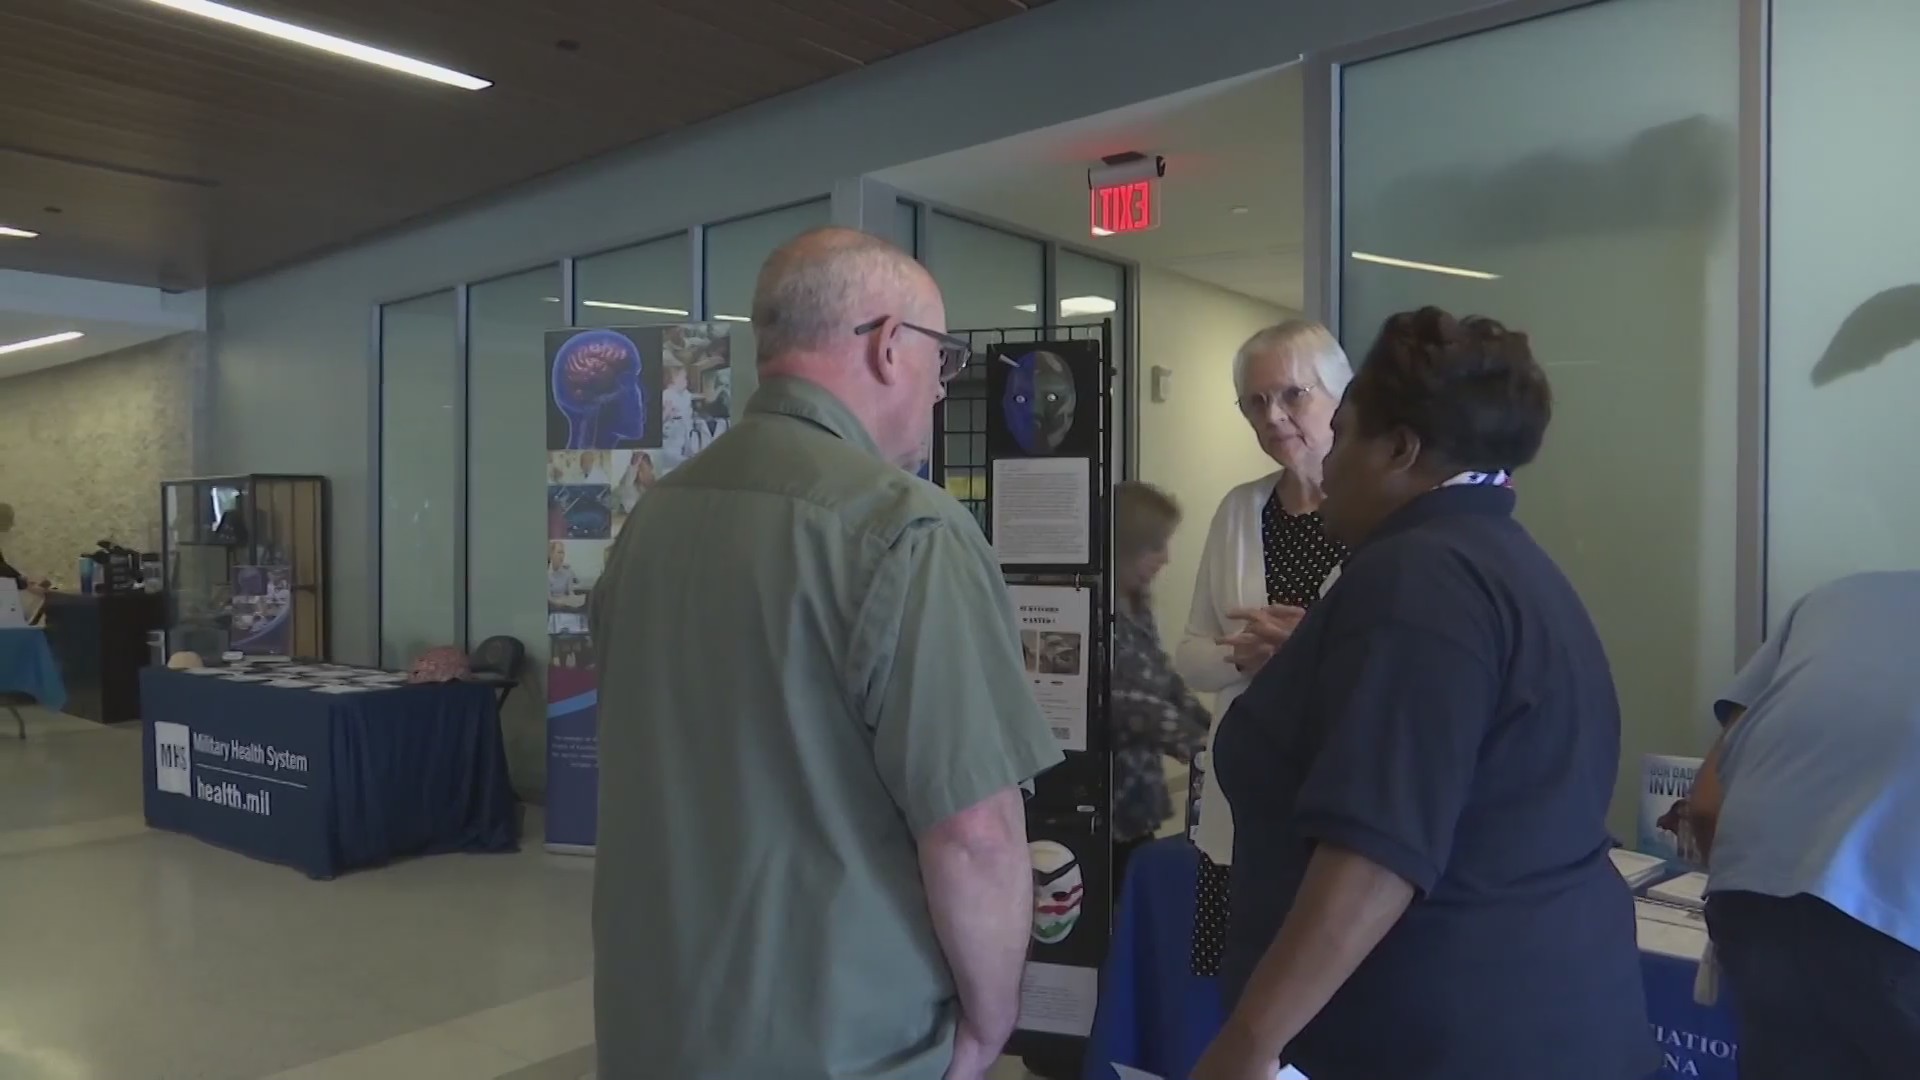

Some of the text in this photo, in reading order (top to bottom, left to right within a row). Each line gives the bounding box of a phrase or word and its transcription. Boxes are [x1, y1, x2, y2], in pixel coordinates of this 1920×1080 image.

[193, 732, 308, 771] Military Health System
[1672, 767, 1694, 779] DAD
[196, 776, 271, 814] health.mil
[1649, 1023, 1738, 1060] IATIO
